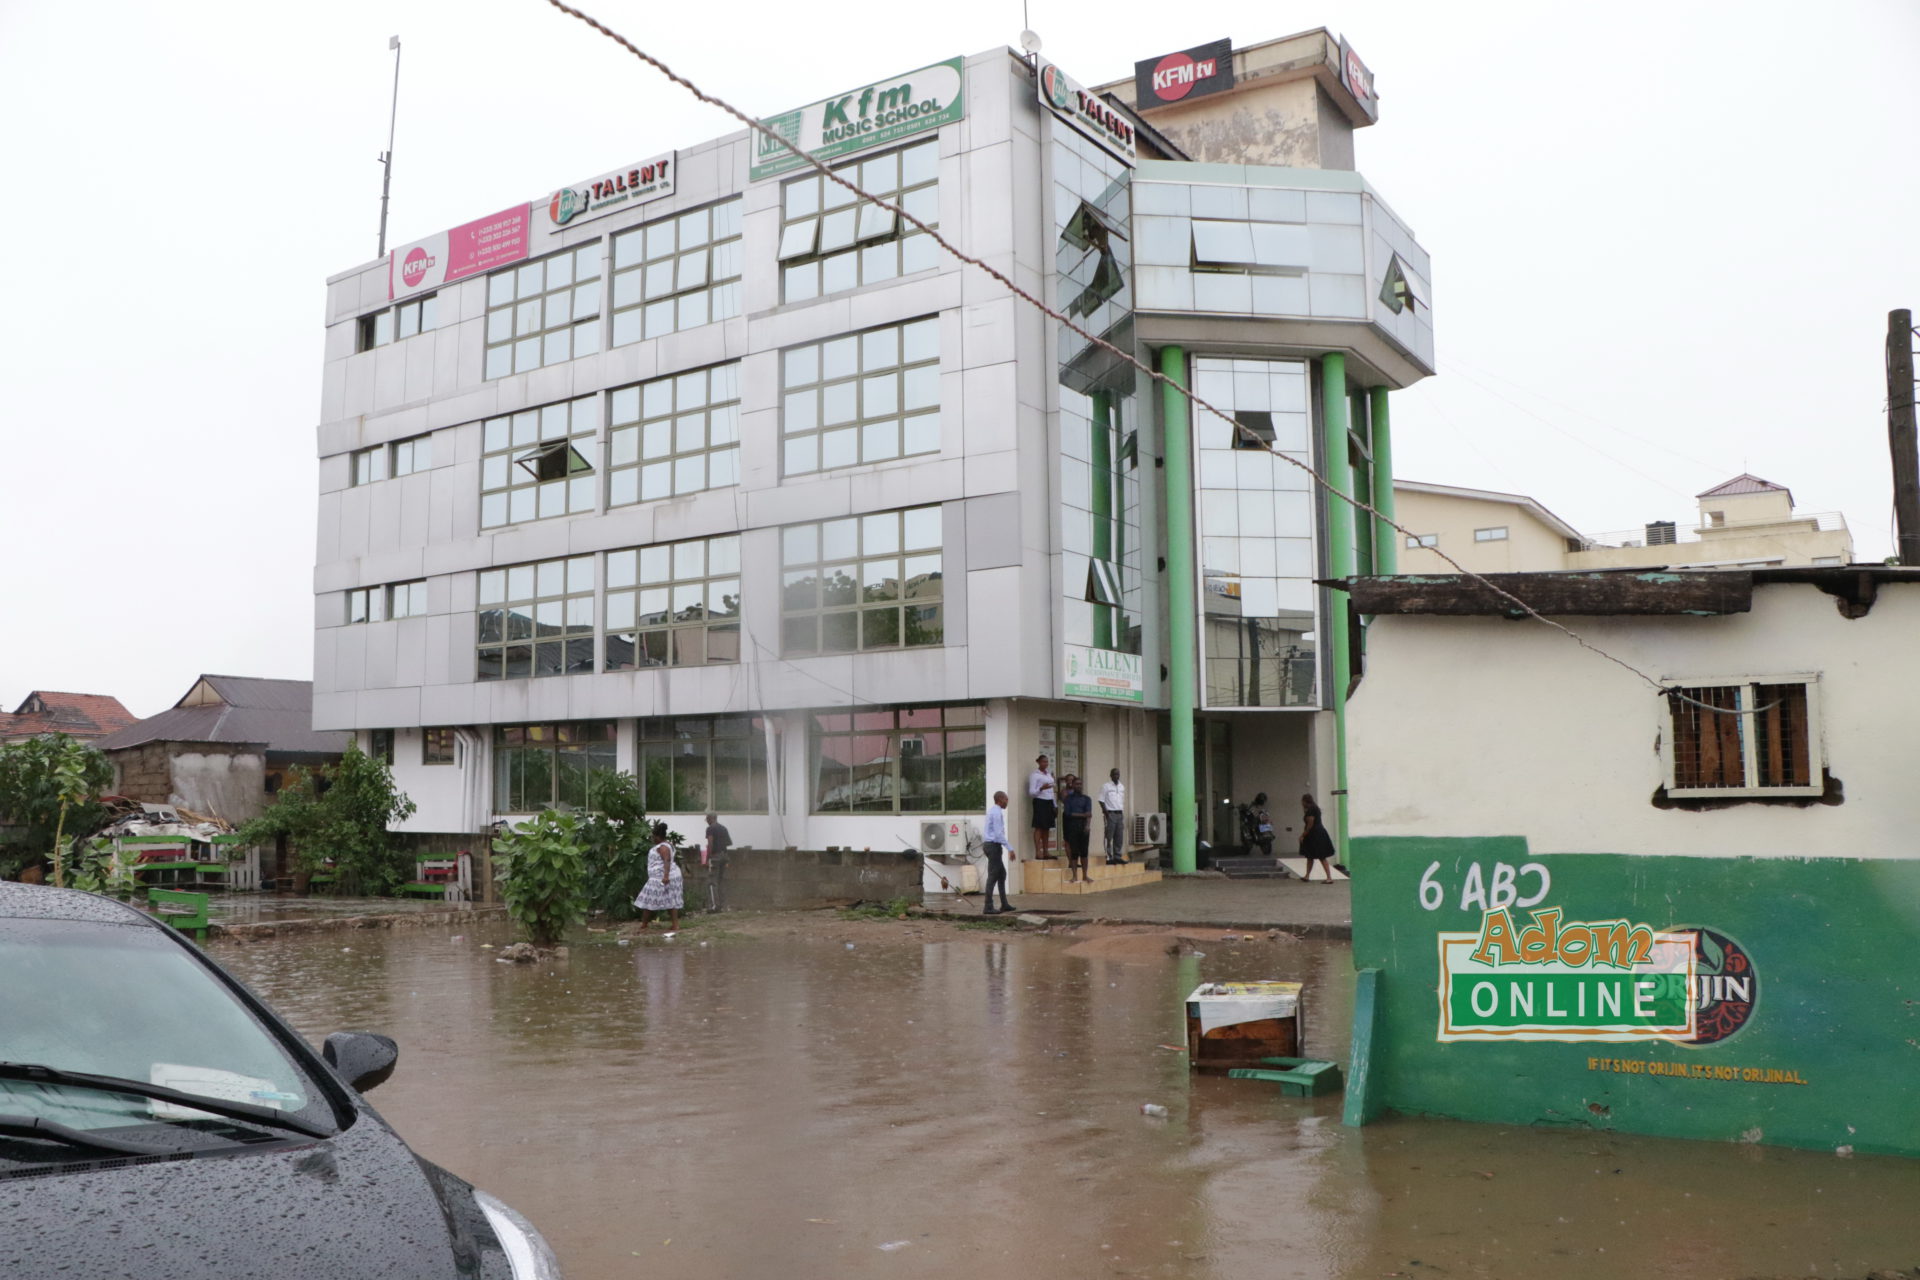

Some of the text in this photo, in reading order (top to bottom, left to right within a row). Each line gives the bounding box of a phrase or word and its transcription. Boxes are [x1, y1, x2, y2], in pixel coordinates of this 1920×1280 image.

[1153, 60, 1214, 91] KFM tv
[822, 83, 912, 130] Kfm
[822, 98, 943, 145] MUSIC SCHOOL
[1076, 90, 1133, 145] TALENT
[591, 160, 669, 200] TALENT
[403, 258, 427, 276] KFM
[1085, 648, 1140, 674] TALENT
[1419, 860, 1444, 911] 6
[1588, 1057, 1599, 1071] IF
[1622, 1059, 1646, 1074] NOT
[1715, 1066, 1740, 1081] NOT
